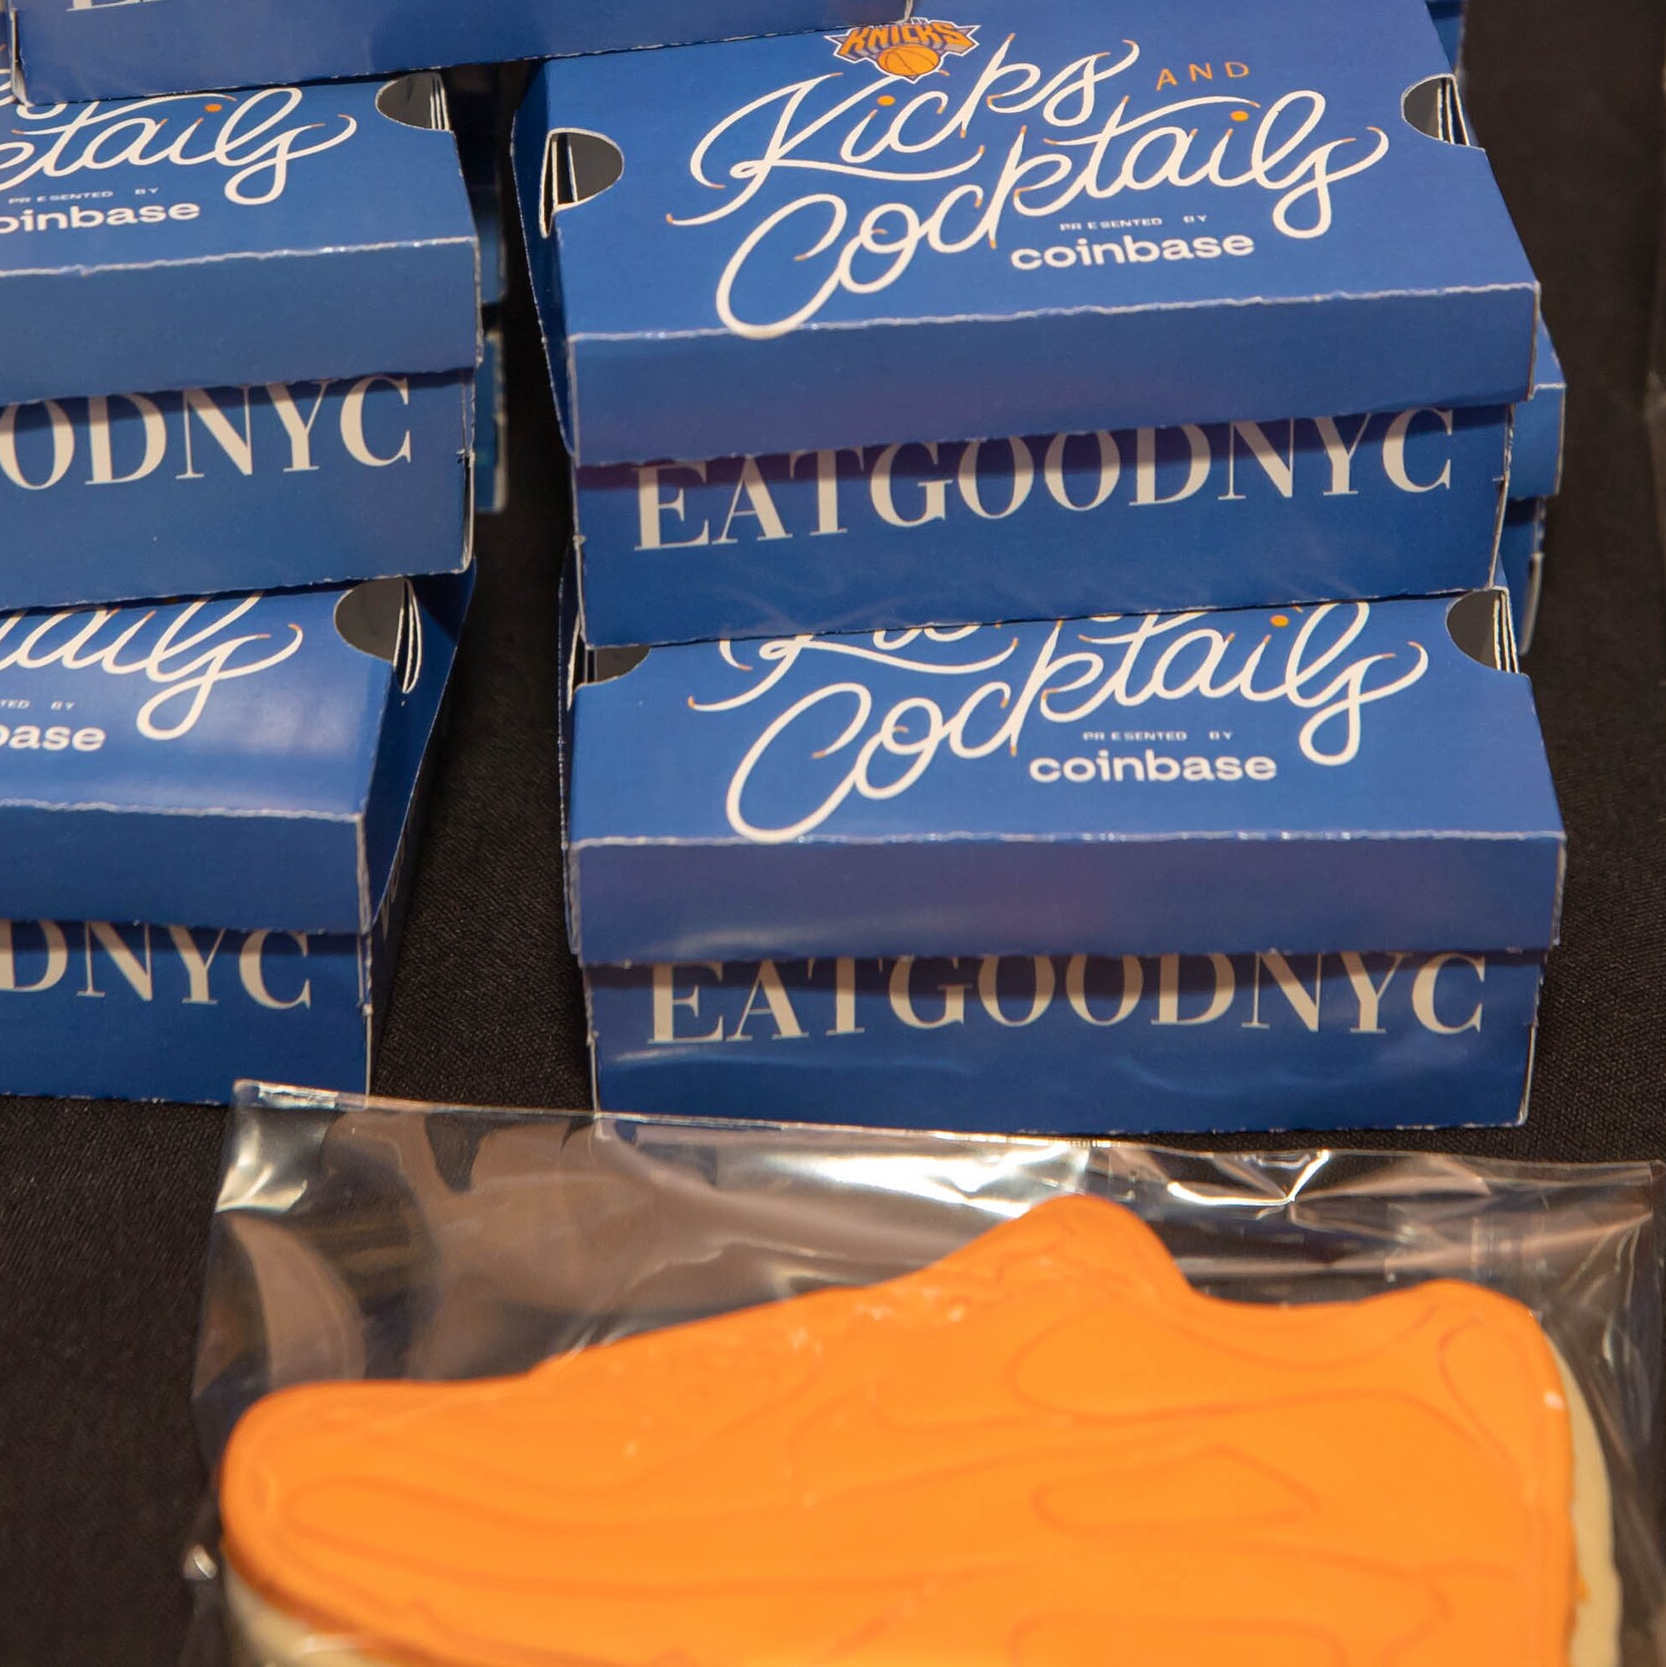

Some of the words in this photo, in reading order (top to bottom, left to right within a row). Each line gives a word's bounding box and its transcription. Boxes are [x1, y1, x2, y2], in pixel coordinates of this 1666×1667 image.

[838, 22, 976, 58] KNICKS
[666, 33, 1140, 227] Kicks
[1156, 61, 1250, 91] AND
[715, 89, 1390, 340] Cocktails
[1010, 235, 1255, 270] coinbase
[633, 407, 1457, 554] EATGOODNYC
[727, 602, 1429, 844] Cocktails
[1029, 749, 1278, 783] coinbase
[646, 951, 1488, 1047] EATGOODNYC
